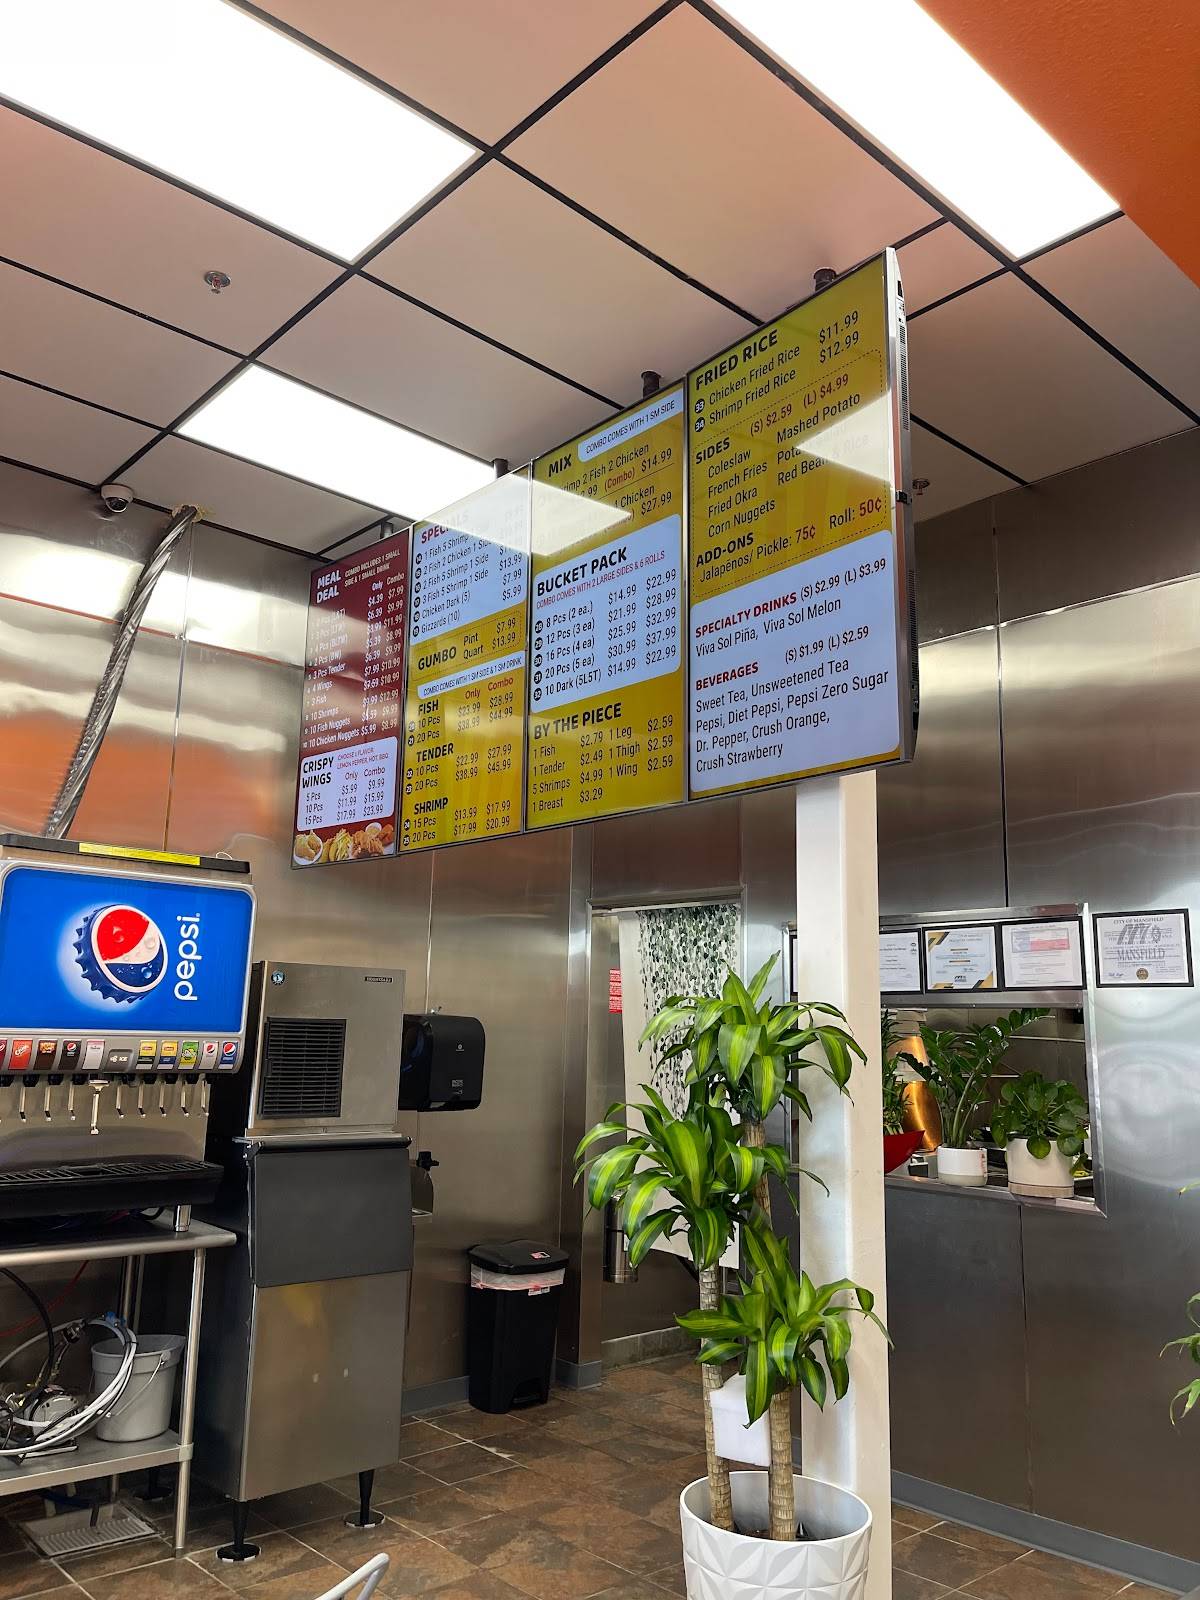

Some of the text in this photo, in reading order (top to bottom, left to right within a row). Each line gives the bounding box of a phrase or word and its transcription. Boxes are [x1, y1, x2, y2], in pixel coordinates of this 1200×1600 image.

[695, 328, 777, 390] FRIED RICE
[709, 375, 746, 405] Chicken
[749, 356, 774, 382] Fried
[777, 345, 799, 366] Rice
[819, 309, 858, 344] $11.99
[709, 398, 742, 425] Shrimp
[745, 379, 770, 405] Fried
[774, 369, 795, 389] Rice
[819, 330, 858, 363] $12.99
[586, 436, 606, 453] COMBO
[607, 425, 627, 442] COMES
[628, 415, 644, 431] WITH
[650, 407, 659, 419] SM
[661, 399, 674, 414] SIDE
[695, 372, 848, 464] SIDES (S) $2.59 (L) $4.99
[708, 392, 859, 478] Coleslaw Mashed Potato
[548, 453, 571, 477] MIX
[604, 447, 671, 492] (Combo) $14.99
[708, 461, 767, 498] French Fries
[708, 495, 731, 518] Fried
[734, 486, 757, 505] Okra
[777, 464, 797, 485] Red
[708, 499, 775, 537] Corn Nuggets
[756, 535, 792, 559] Pickle:
[795, 524, 815, 543] 75¢
[829, 507, 855, 529] Roll:
[859, 496, 881, 517] 50¢
[696, 531, 753, 567] ADD-ONS
[317, 569, 341, 589] MEAL
[386, 571, 404, 585] Combo
[427, 588, 439, 602] Fish
[446, 578, 467, 594] Shrimp
[474, 567, 488, 581] Side
[499, 552, 522, 571] $13.99
[536, 594, 555, 609] COMBO
[556, 586, 575, 601] COMES
[576, 580, 590, 592] WITH
[596, 569, 615, 585] LARGE
[616, 562, 633, 577] SIDES
[644, 549, 664, 565] ROLLS
[537, 546, 626, 596] BUCKET PACK
[316, 584, 339, 603] DEAL
[421, 602, 444, 618] Chicken
[502, 567, 521, 585] $7.99
[421, 584, 521, 633] Gizzards (10) $5.99
[552, 613, 566, 625] Pcs
[578, 600, 592, 616] ea.)
[608, 583, 636, 605] $14.99
[646, 568, 676, 591] $22.99
[695, 557, 885, 638] SPECIALTY DRINKS (S) $2.99 (L) $3.99
[463, 617, 515, 646] Pint $7.99
[463, 631, 515, 659] Quart $13.99
[695, 642, 714, 657] Viva
[717, 633, 731, 650] Sol
[763, 618, 784, 634] Viva
[787, 607, 804, 626] Sol
[807, 598, 840, 619] Melon
[417, 646, 456, 670] GUMBO
[695, 625, 868, 690] BEVERAGES (S) $1.99 (L) $2.59
[695, 659, 848, 712] Sweet Tea, Unsweetened Tea
[696, 670, 888, 733] Pepsi, Diet Pepsi, Pepsi Zero Sugar
[534, 702, 621, 739] BY THE PIECE
[540, 743, 555, 756] Fish
[580, 730, 603, 748] $2.79
[615, 725, 631, 739] Leg
[647, 714, 672, 732] $2.59
[696, 710, 829, 752] Dr. Pepper, Crush Orange,
[302, 756, 333, 773] CRISPY
[363, 765, 385, 776] Combo
[415, 765, 424, 776] 10
[424, 763, 438, 774] Pcs
[416, 742, 453, 762] TENDER
[696, 743, 783, 772] Crush Strawberry
[302, 771, 331, 788] WINGS
[413, 796, 448, 815] SHRIMP
[1117, 948, 1165, 961] MANSFIELD
